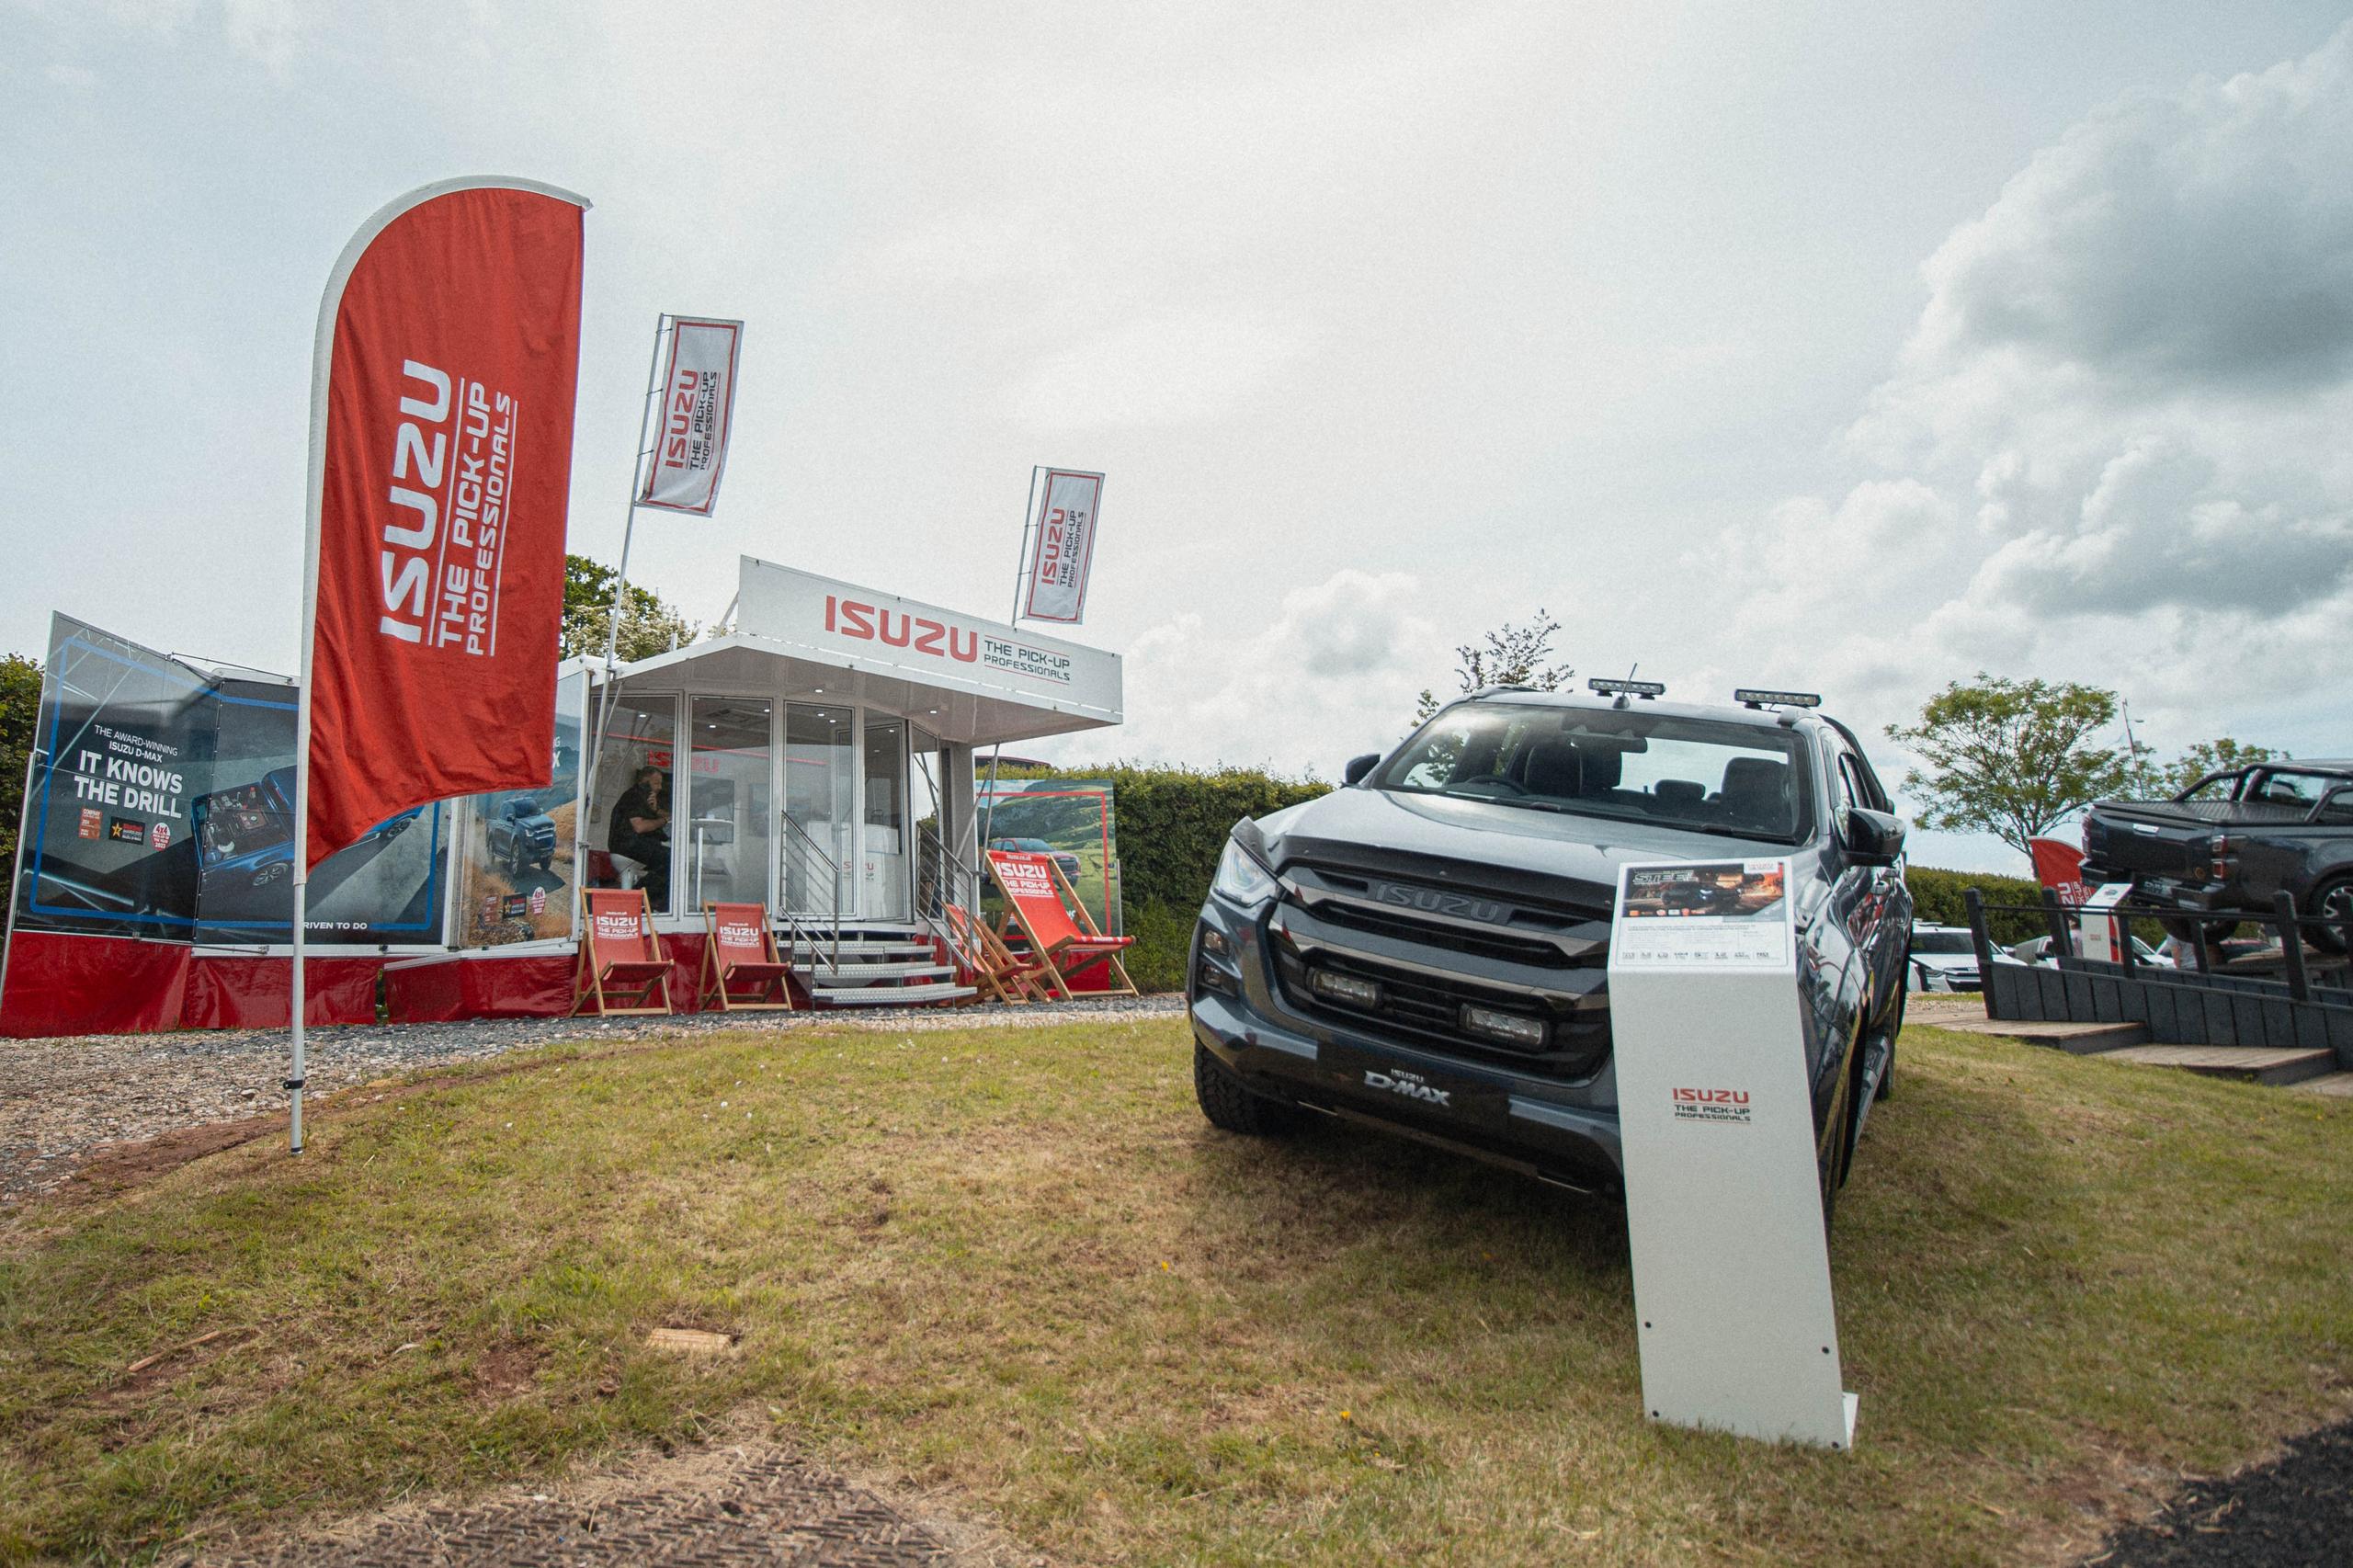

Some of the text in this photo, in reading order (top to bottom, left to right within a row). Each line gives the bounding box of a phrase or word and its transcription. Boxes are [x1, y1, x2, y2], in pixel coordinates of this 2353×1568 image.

[665, 369, 699, 468] ISUZU
[689, 371, 710, 471] THE PICK-UP
[699, 371, 718, 471] PROFESSIONALS
[381, 359, 451, 643] ISUZU
[438, 381, 491, 648] THE PICK-UP
[466, 392, 511, 655] PROFESSIONALS
[1041, 508, 1065, 585] ISUZU
[1059, 510, 1077, 586] THE PICK-UP
[1067, 511, 1084, 588] PROFESSIONALS
[825, 596, 977, 663] ISUZU
[984, 640, 1070, 669] THE PICK-UP
[984, 653, 1070, 681] PROFESSIONALS
[95, 724, 178, 756] THE AWARD-WINNING
[109, 741, 163, 763] ISUZU D-MAX
[79, 750, 183, 794] IT KNOWS
[74, 775, 182, 819] THE DRILL
[995, 861, 1047, 879] ISUZU
[1377, 883, 1499, 920] ISUZU
[597, 915, 638, 926] ISUZU
[720, 926, 759, 937] ISUZU
[1364, 1070, 1450, 1107] D-MAX
[1391, 1068, 1424, 1083] ISUZU
[1673, 1087, 1749, 1104] ISUZU
[1702, 1106, 1750, 1115] PICK-UP
[1675, 1112, 1751, 1121] PROFESSIONALS
